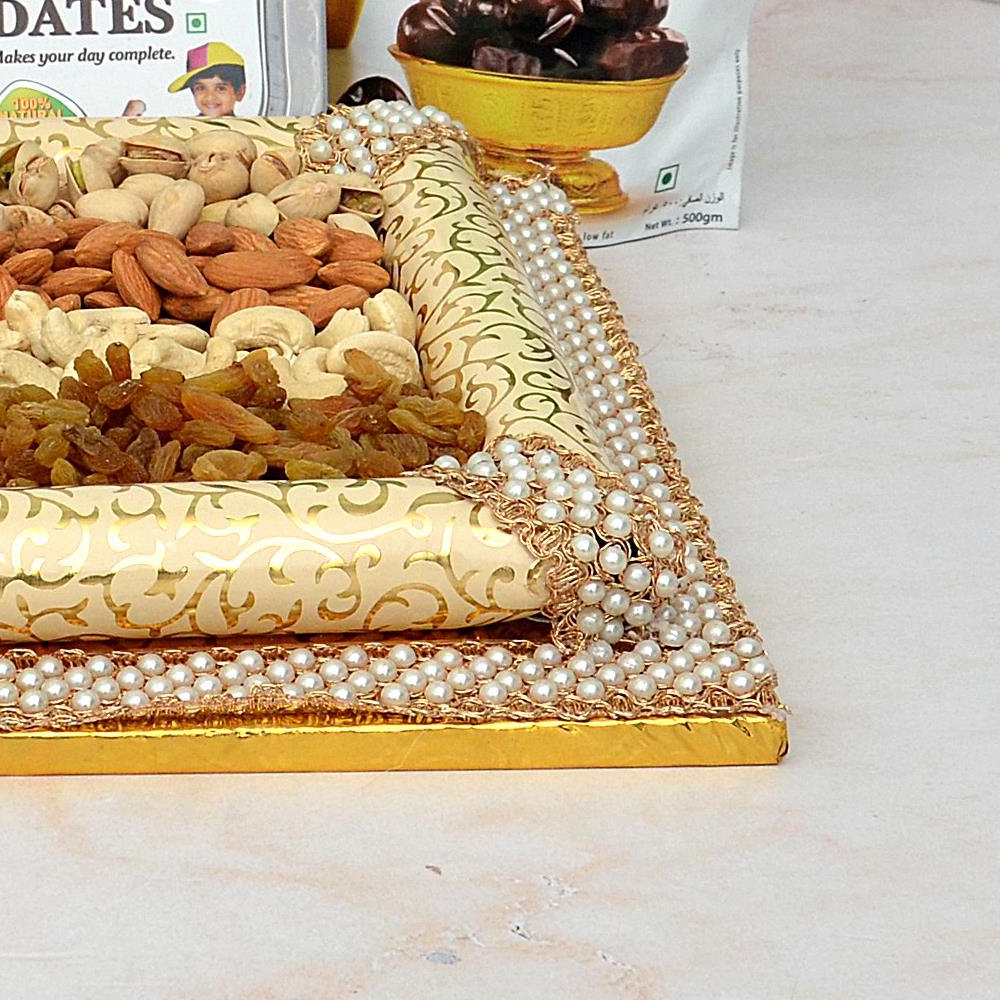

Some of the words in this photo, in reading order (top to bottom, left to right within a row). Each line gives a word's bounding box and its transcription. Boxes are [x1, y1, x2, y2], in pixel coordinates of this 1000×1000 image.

[39, 52, 75, 67] your
[77, 48, 106, 66] day
[108, 46, 176, 64] complete.
[14, 98, 51, 110] 100%
[645, 222, 659, 231] Net
[682, 211, 724, 225] 500gm
[601, 230, 614, 241] fat
